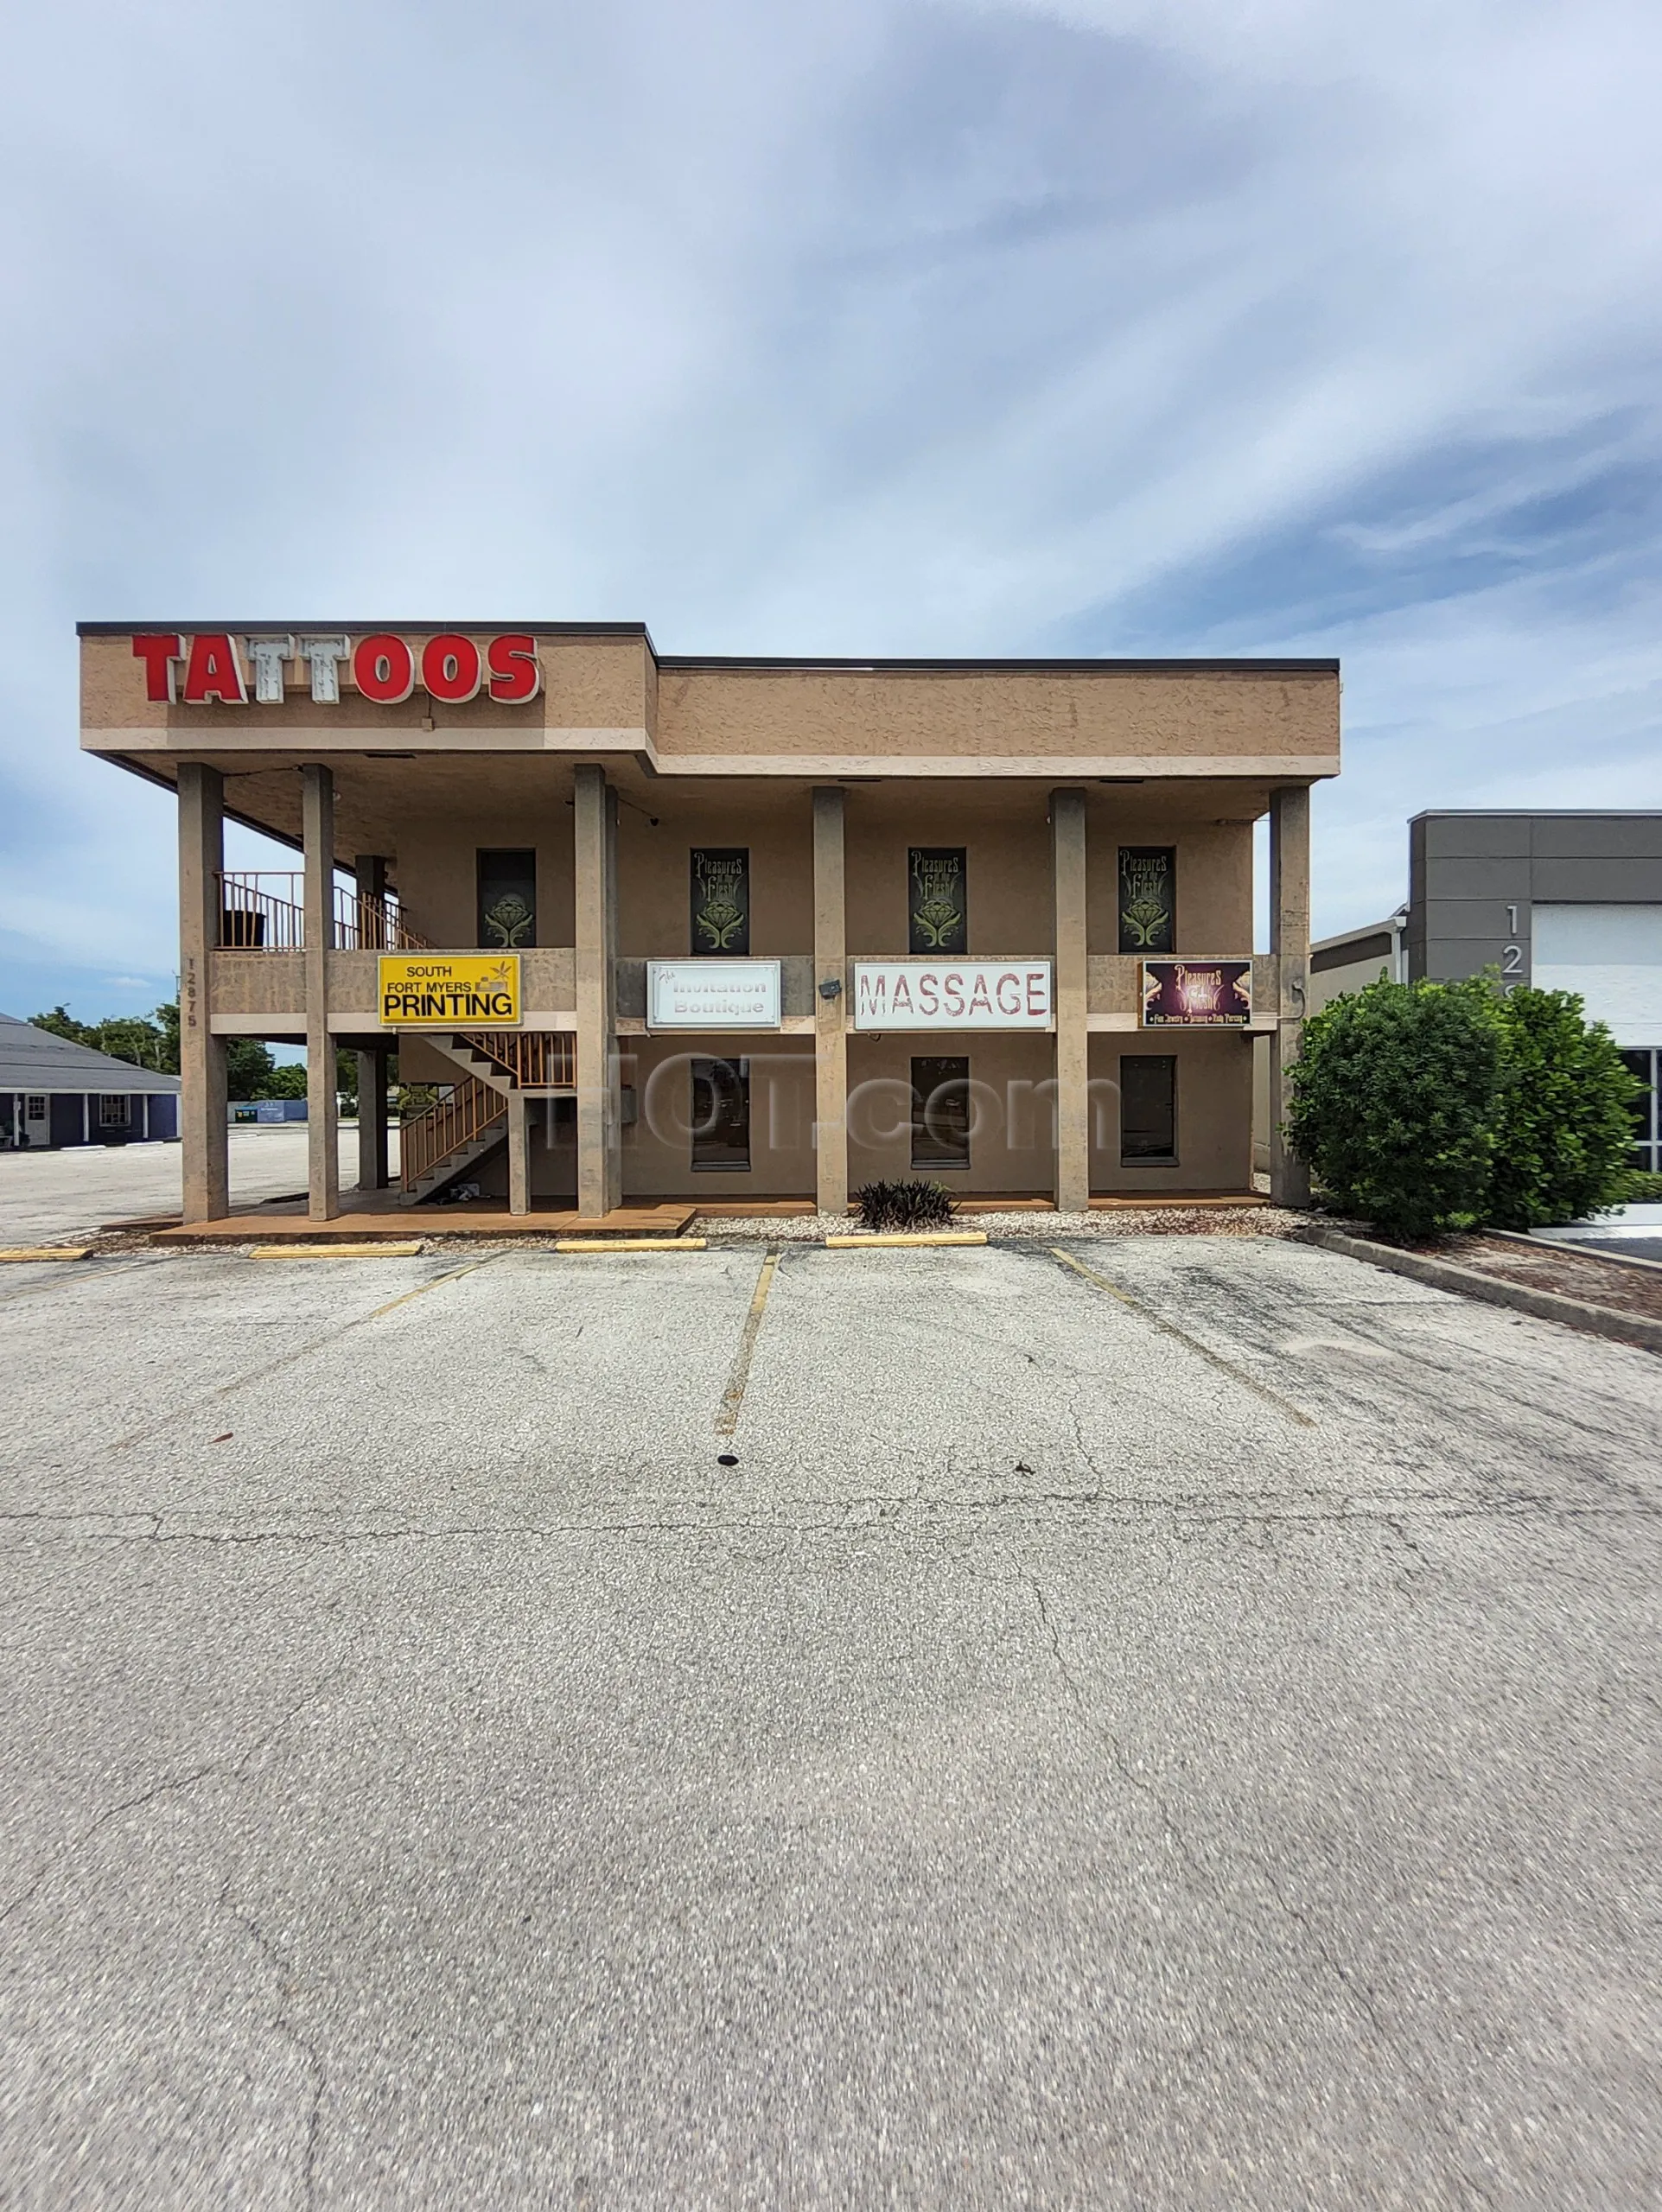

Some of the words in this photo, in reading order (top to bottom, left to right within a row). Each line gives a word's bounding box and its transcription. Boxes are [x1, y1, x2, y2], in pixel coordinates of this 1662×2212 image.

[132, 633, 540, 705] TATTOOS
[406, 966, 452, 977] SOUTH
[188, 958, 196, 1027] 12875
[387, 982, 422, 993] FORT
[426, 982, 472, 993] MYERS
[673, 981, 767, 993] Invitation
[860, 973, 1048, 1016] MASSAGE
[384, 993, 513, 1017] PRINTING
[674, 1000, 765, 1015] Boutique
